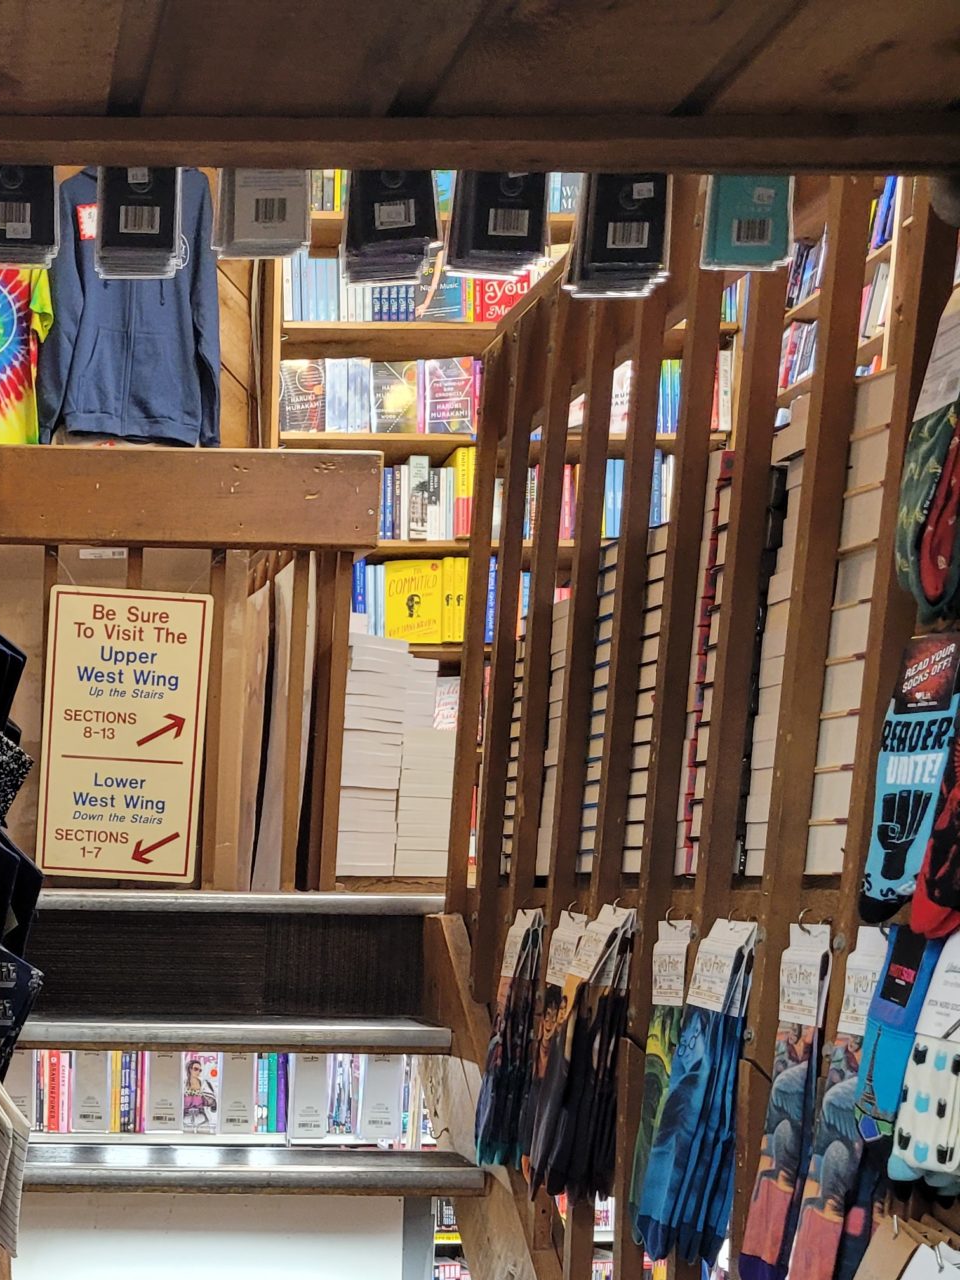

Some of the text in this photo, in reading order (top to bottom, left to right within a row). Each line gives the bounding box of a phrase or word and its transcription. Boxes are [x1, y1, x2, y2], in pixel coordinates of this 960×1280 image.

[286, 402, 323, 411] MURAKAMI
[431, 410, 469, 419] MURAKAMI
[92, 604, 170, 624] Be Sure
[74, 622, 188, 645] To Visit The
[100, 646, 158, 665] Upper
[904, 643, 956, 680] READ YOUR
[77, 666, 179, 691] West Wing
[902, 656, 953, 694] SOCKS OFF!
[89, 687, 165, 700] Up the Stairs
[63, 709, 137, 725] SECTIONS
[83, 727, 115, 740] 8-13
[886, 752, 945, 785] UNITE!
[93, 773, 146, 789] Lower
[73, 792, 166, 815] West Wing
[72, 810, 163, 825] Down the Stairs
[54, 828, 129, 845] SECTIONS
[80, 847, 102, 858] 1-7
